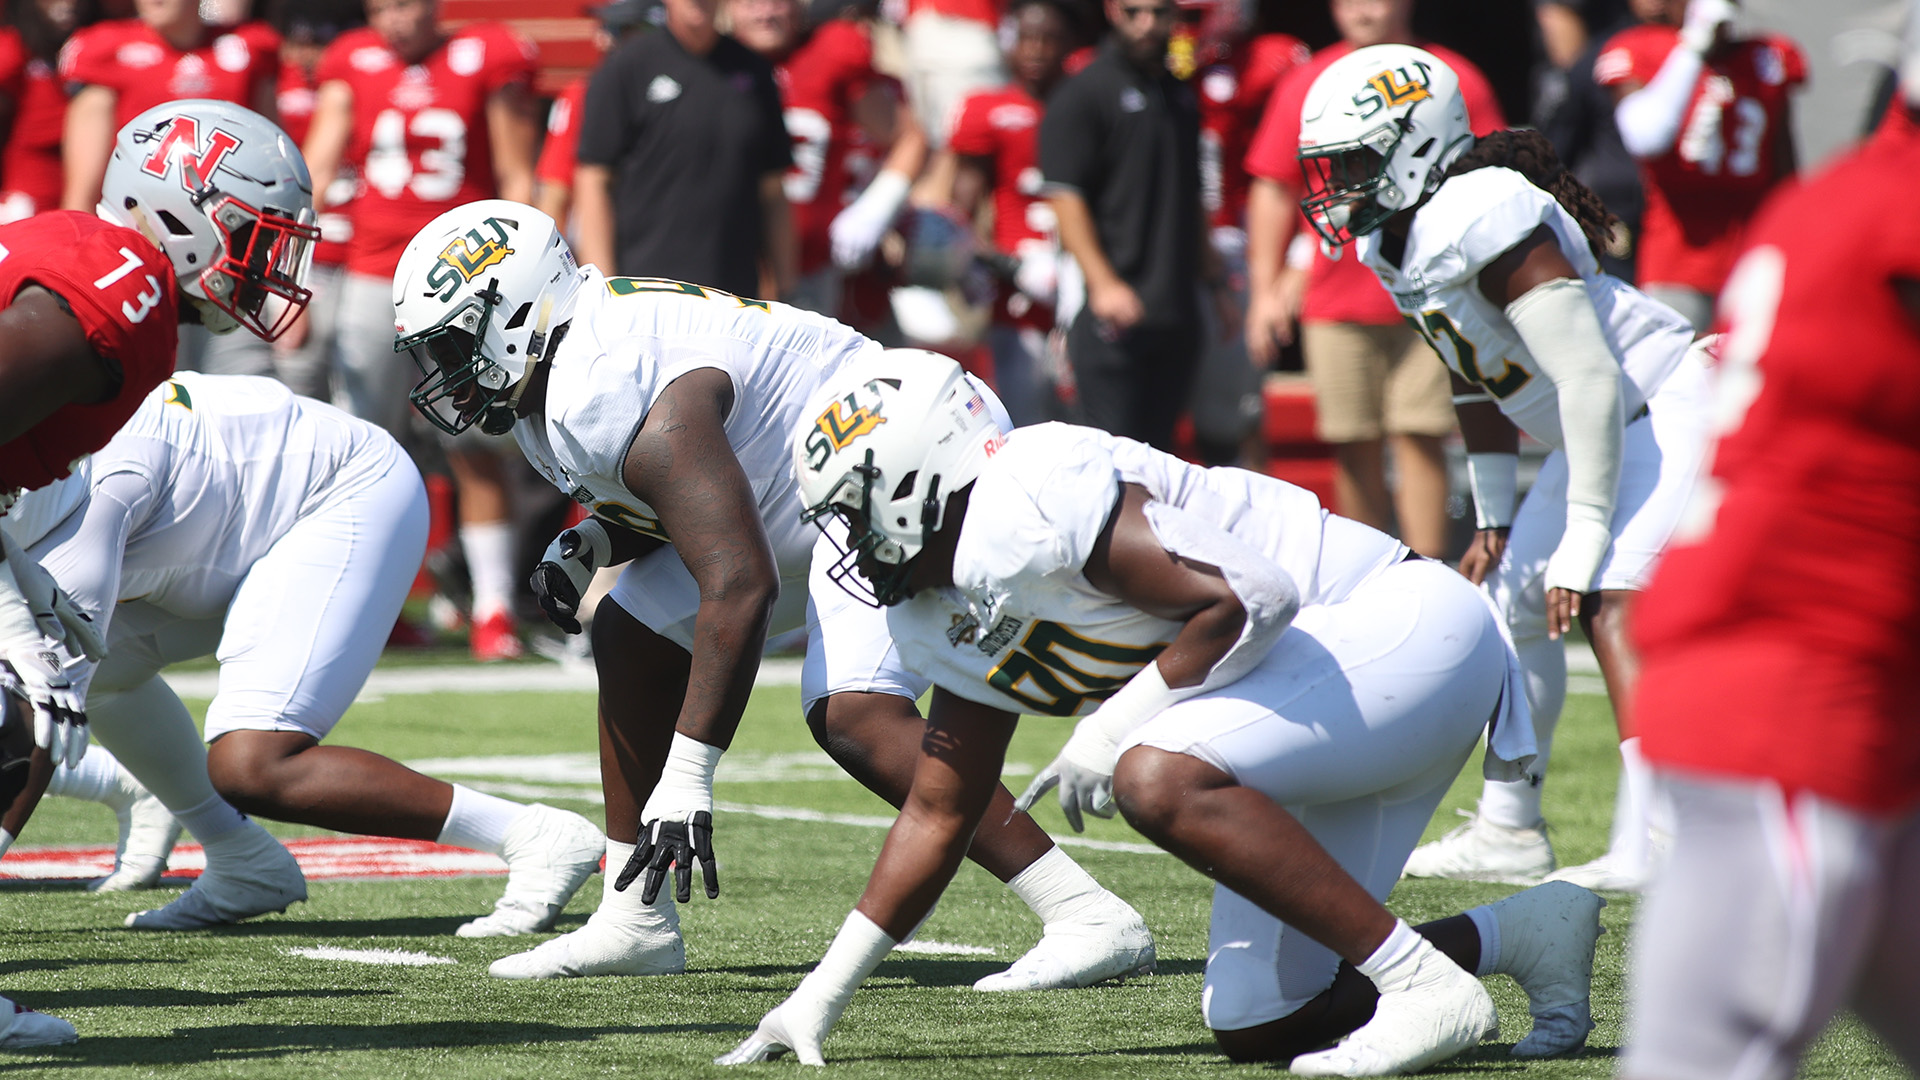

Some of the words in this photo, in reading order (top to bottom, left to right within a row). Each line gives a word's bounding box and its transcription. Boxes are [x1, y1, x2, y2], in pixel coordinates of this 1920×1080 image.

[1352, 61, 1430, 120] SLU
[141, 114, 243, 194] N
[364, 108, 467, 200] 43
[93, 247, 162, 324] 73
[427, 217, 509, 303] SLU
[806, 378, 884, 472] SLU
